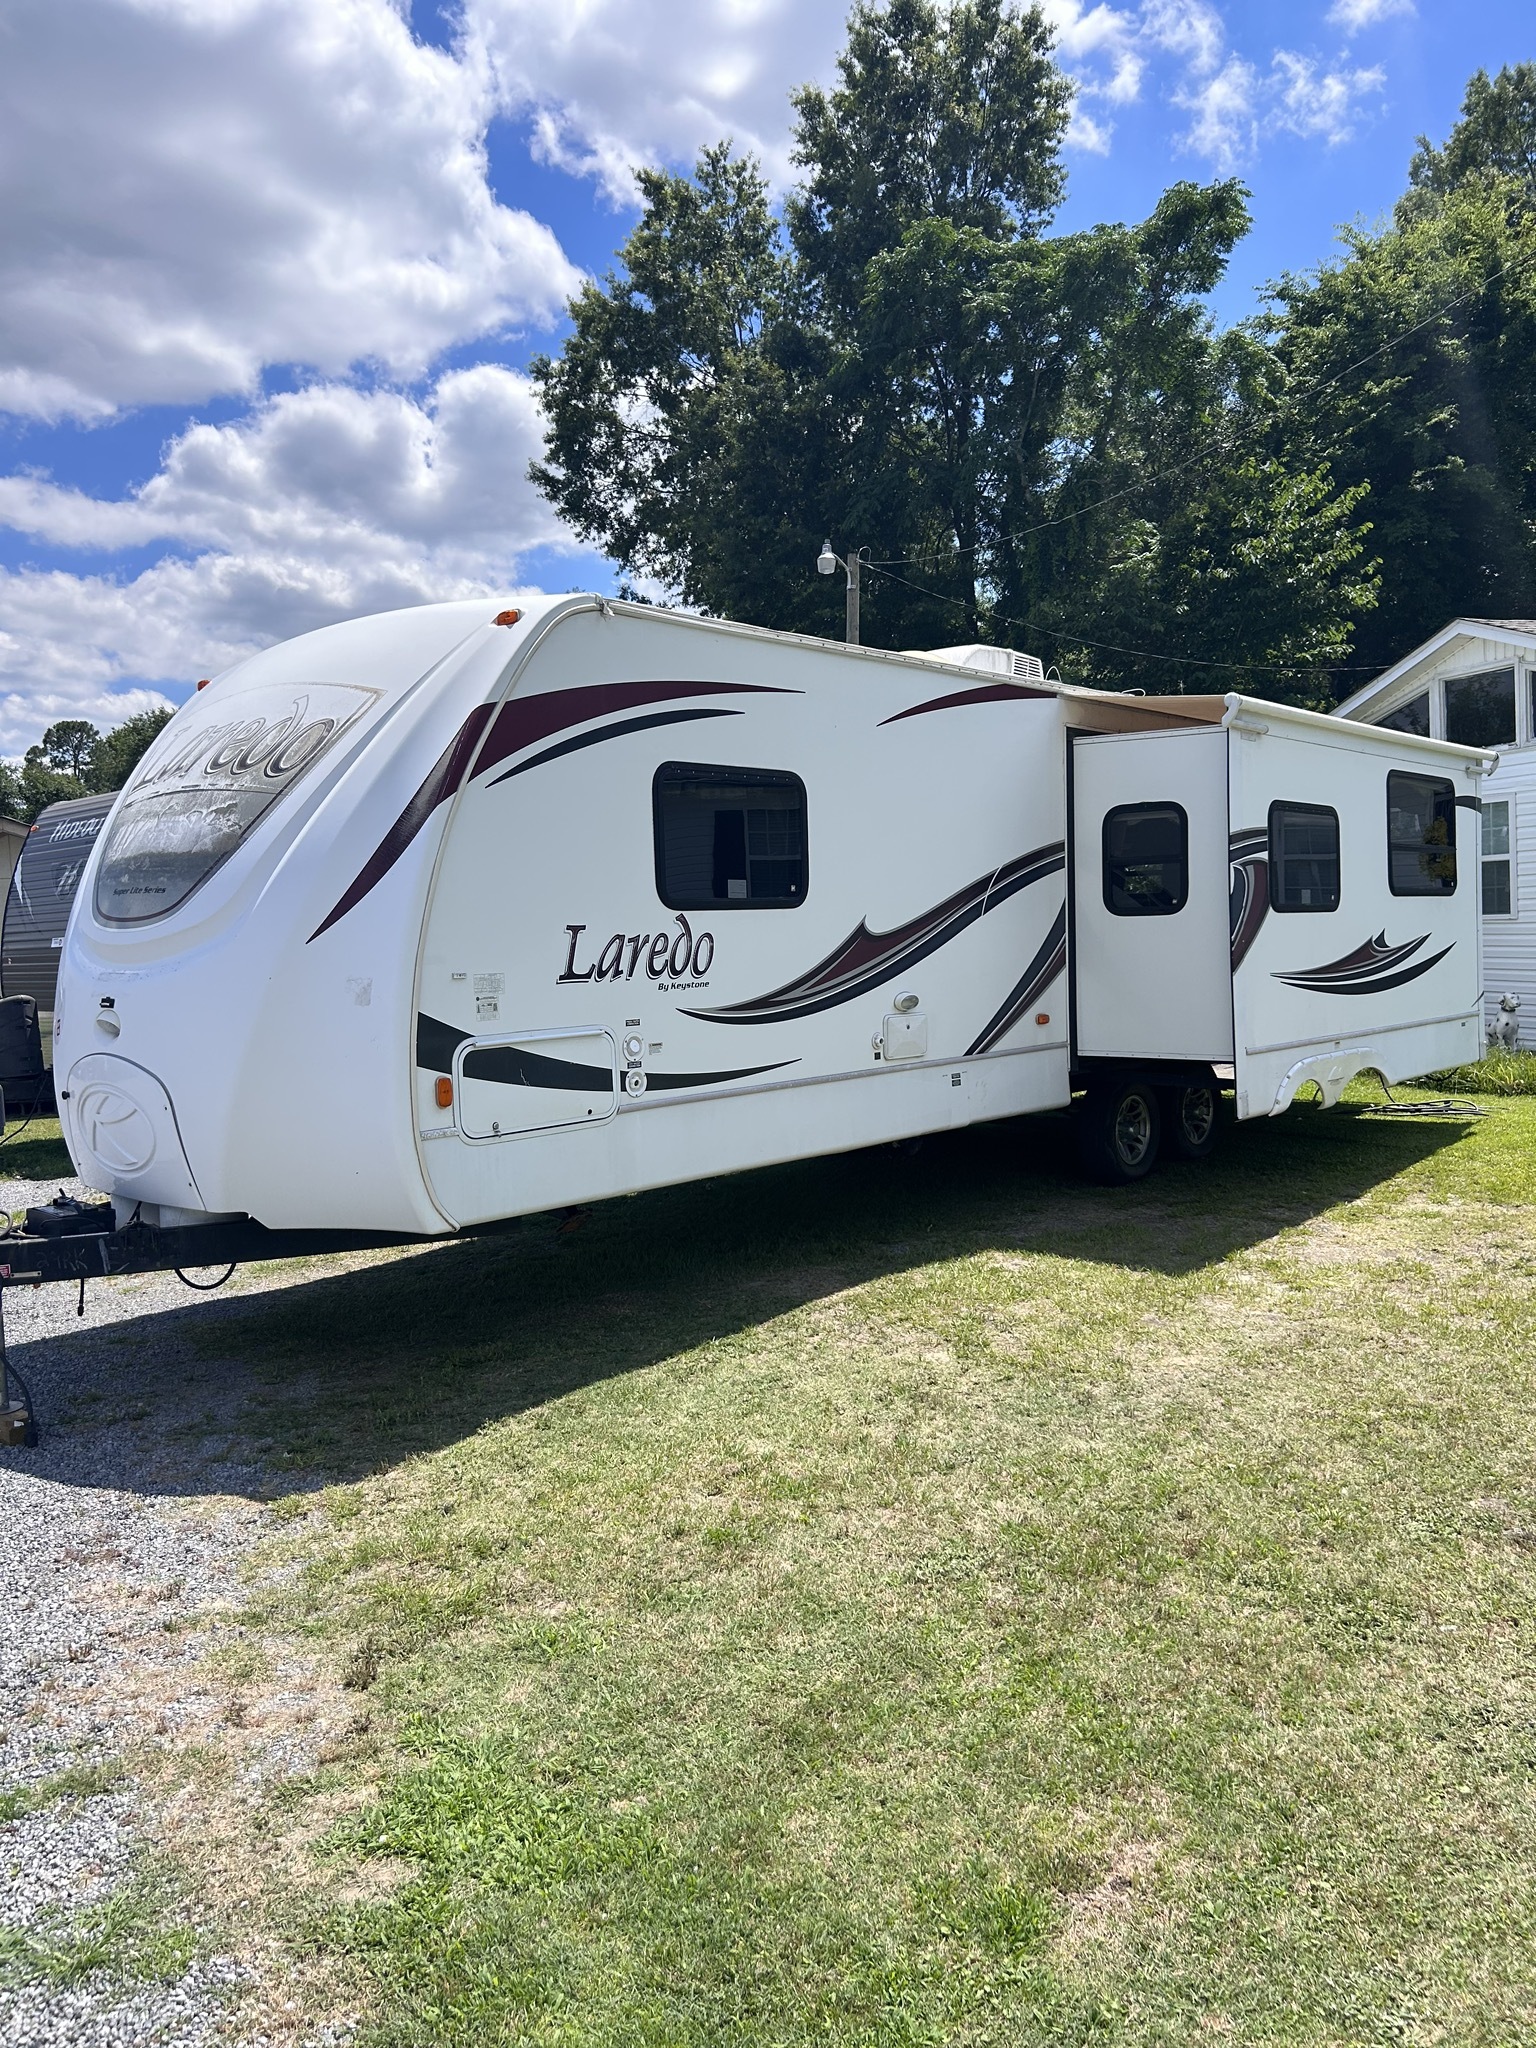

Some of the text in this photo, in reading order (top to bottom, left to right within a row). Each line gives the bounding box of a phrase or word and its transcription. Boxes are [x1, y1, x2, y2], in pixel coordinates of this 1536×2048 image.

[49, 818, 105, 842] HIDEOU
[113, 886, 166, 896] Super Lite Series
[556, 913, 715, 985] Laredo
[658, 981, 710, 992] By Keystone
